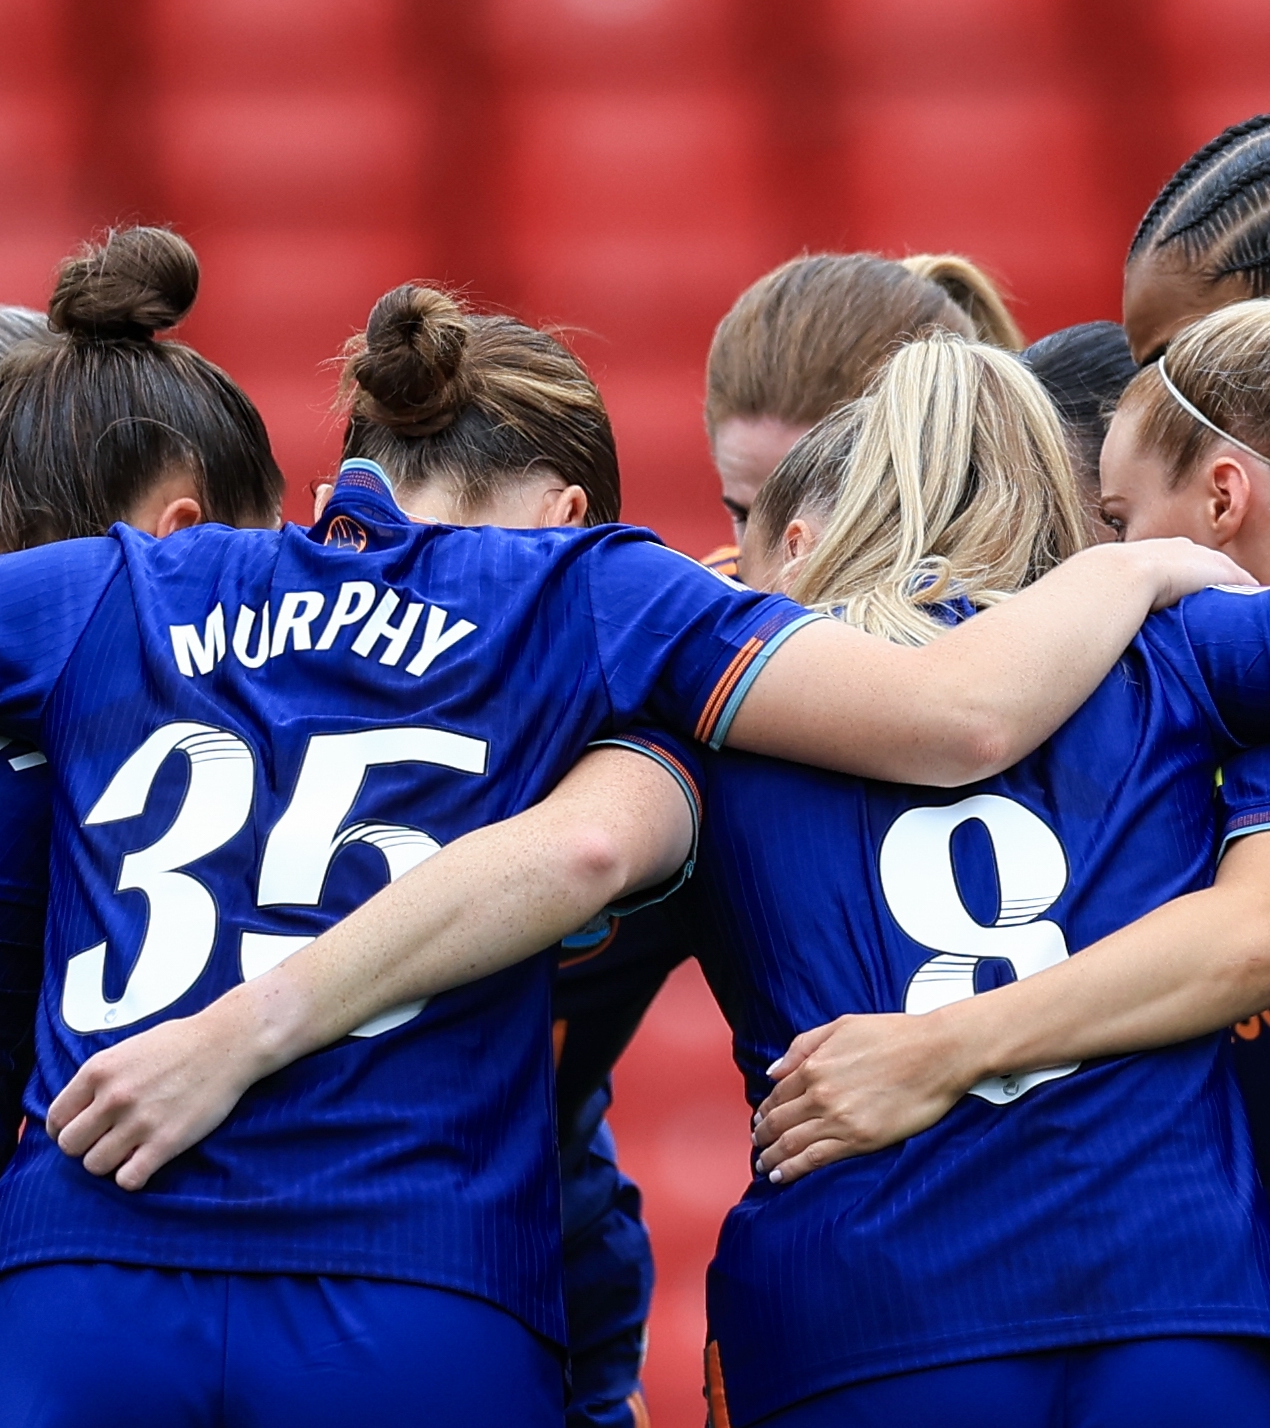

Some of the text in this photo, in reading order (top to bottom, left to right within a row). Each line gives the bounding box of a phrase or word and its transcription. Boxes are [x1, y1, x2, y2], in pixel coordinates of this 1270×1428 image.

[170, 580, 477, 678] MURPHY
[61, 721, 488, 1038] 35
[878, 793, 1081, 1106] 8
